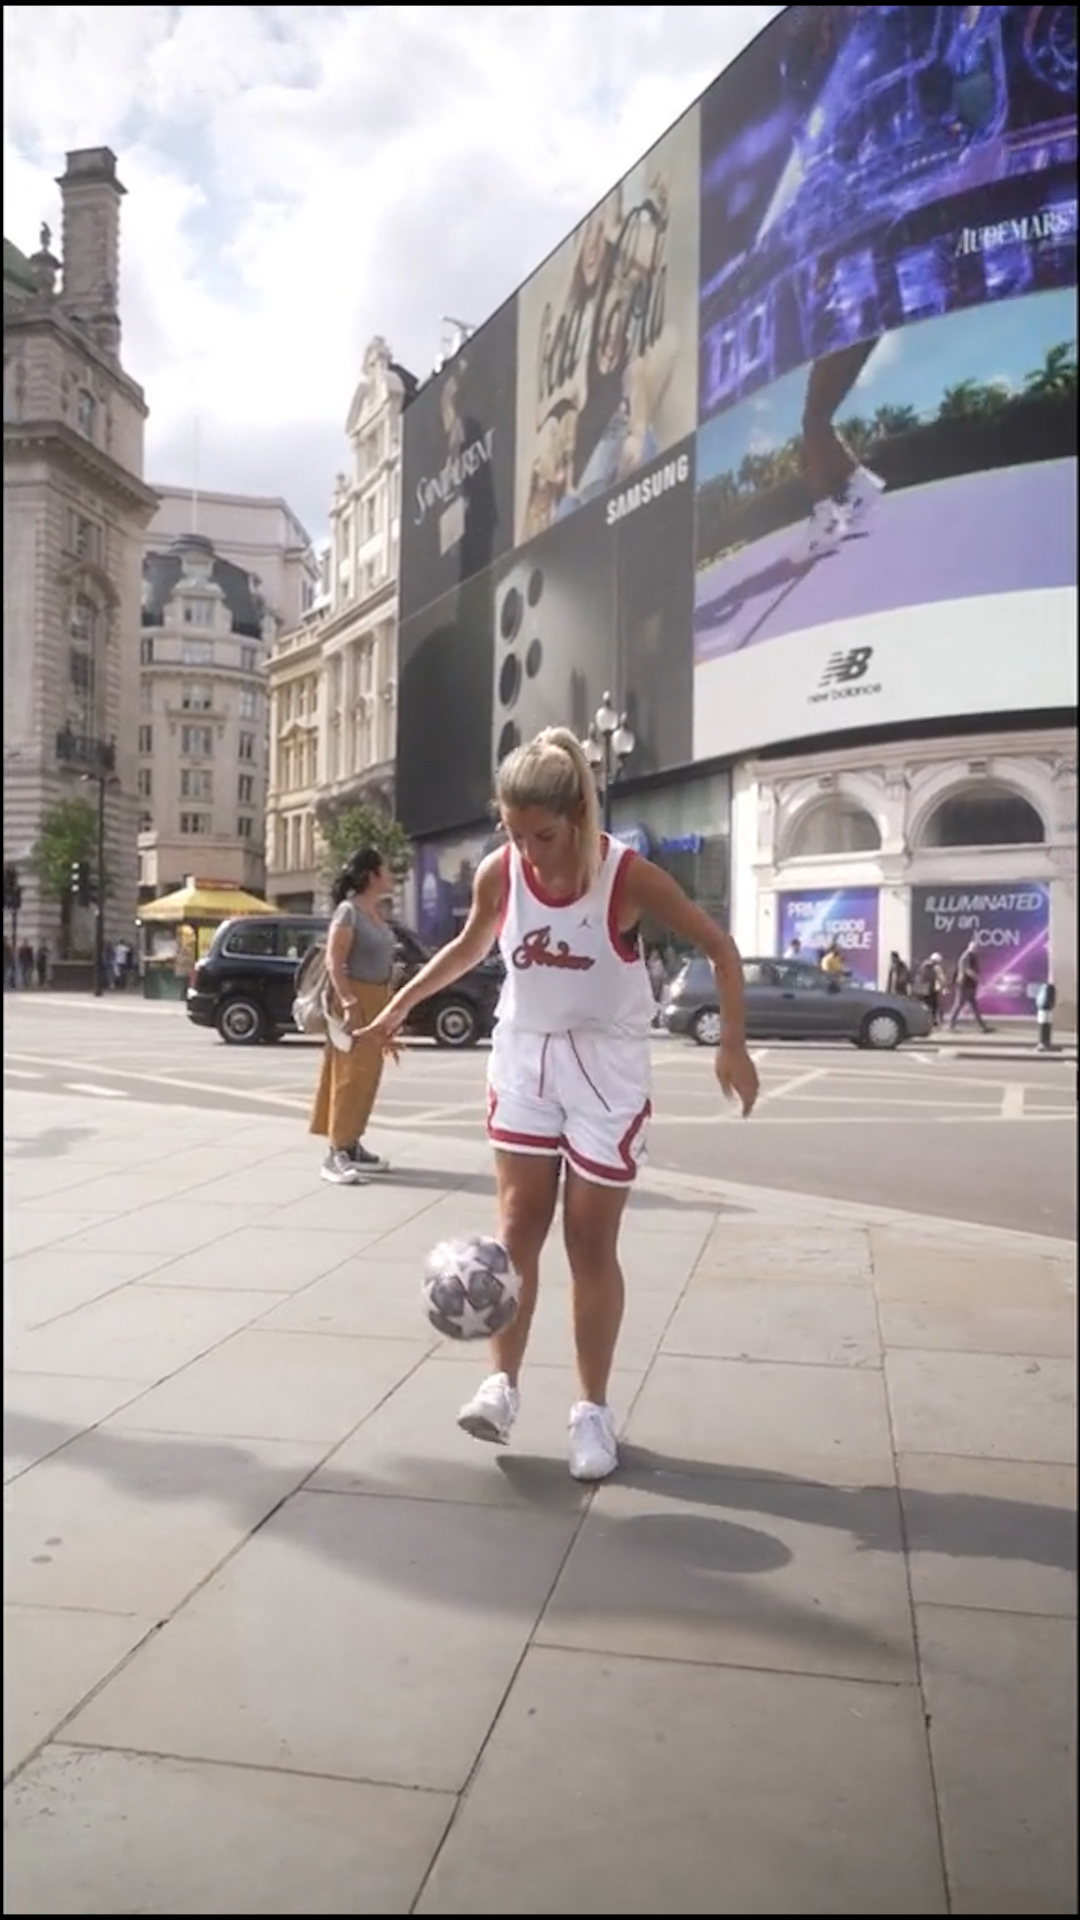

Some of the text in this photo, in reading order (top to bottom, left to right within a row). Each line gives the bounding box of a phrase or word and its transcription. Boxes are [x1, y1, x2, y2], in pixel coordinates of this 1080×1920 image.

[955, 209, 1072, 257] AUDEMARS
[606, 454, 689, 525] SAMSUNG
[807, 683, 882, 704] new balance
[925, 893, 1043, 912] ILLUMINATED
[934, 913, 980, 932] by an
[973, 928, 1020, 946] ICON
